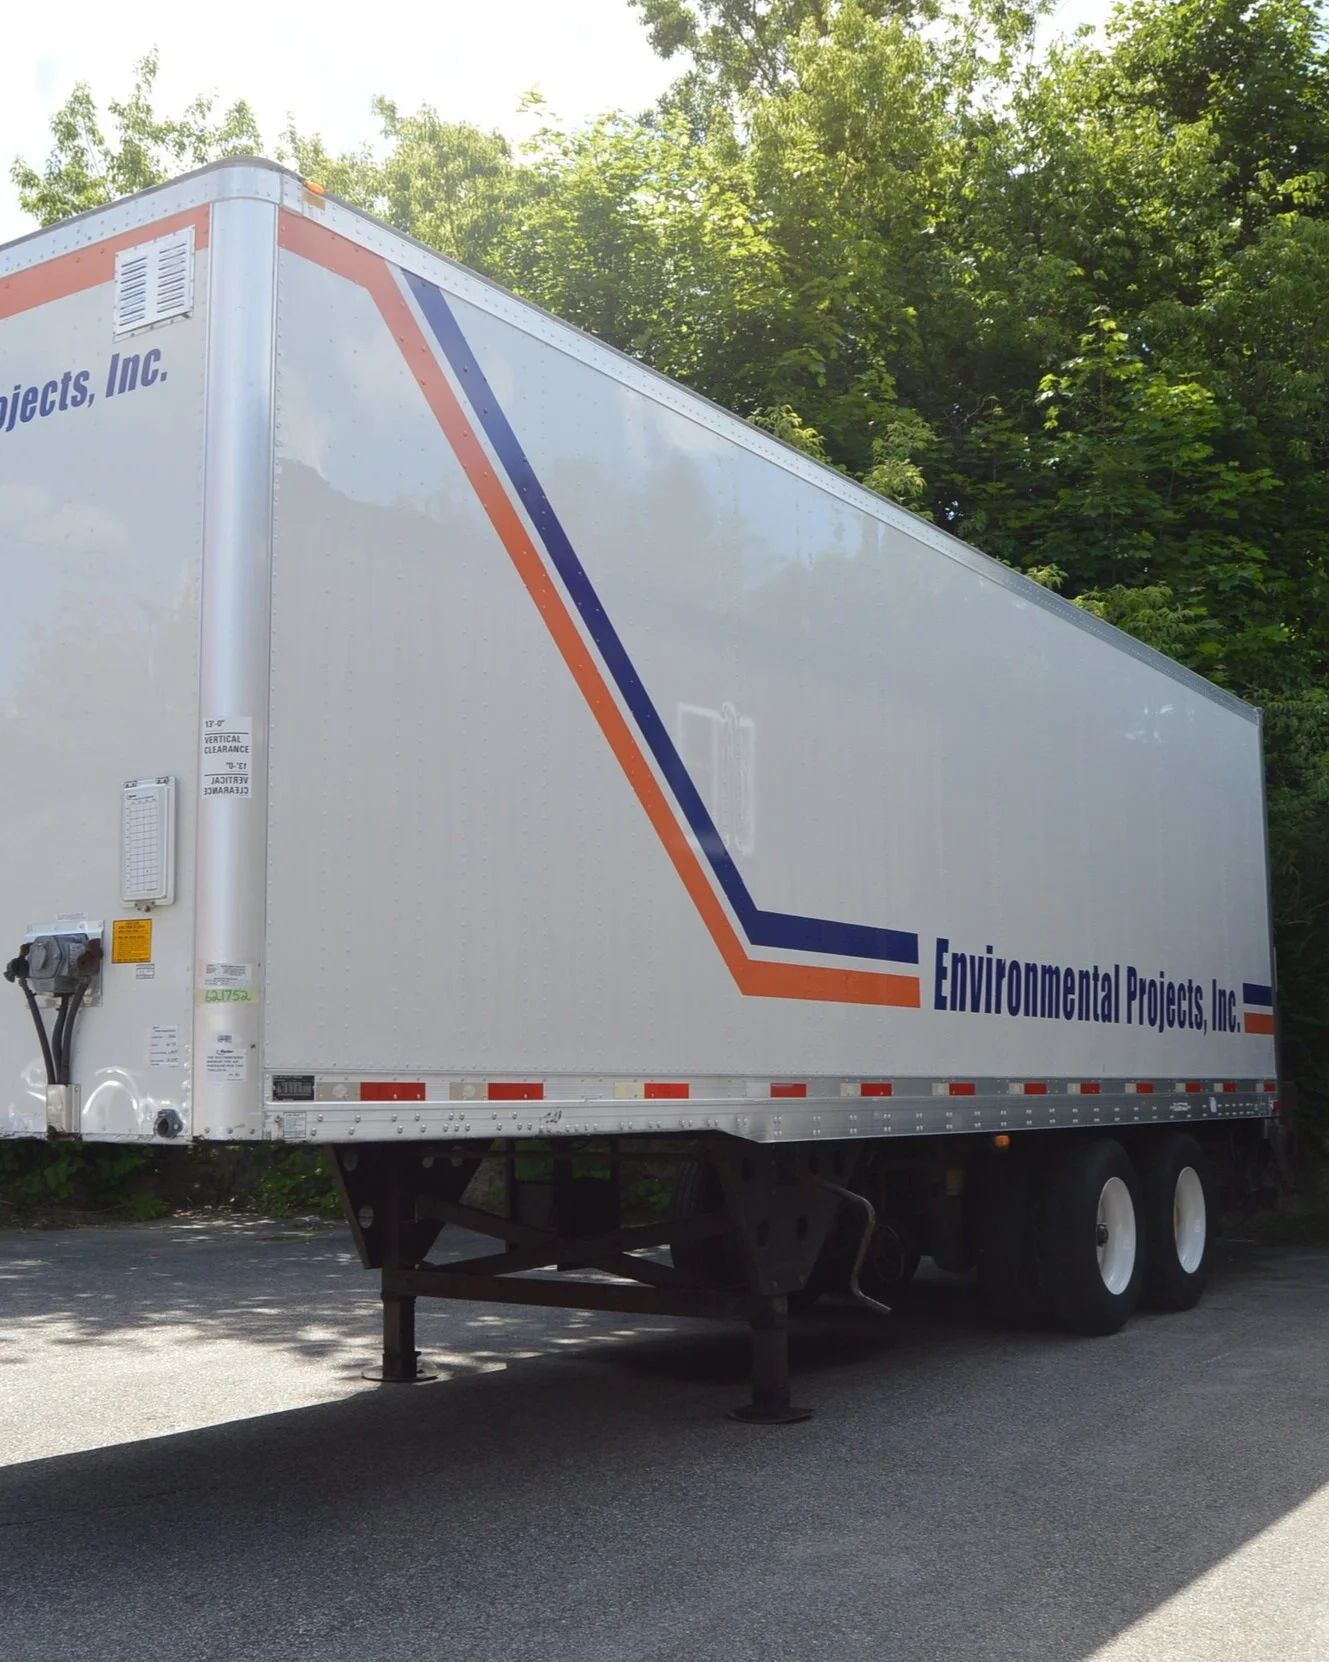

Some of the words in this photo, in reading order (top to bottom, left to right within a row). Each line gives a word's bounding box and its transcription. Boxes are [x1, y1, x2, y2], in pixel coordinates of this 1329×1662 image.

[105, 348, 168, 398] Inc.
[204, 735, 241, 744] VERTICAL
[204, 745, 249, 754] CLEARANCE
[933, 937, 1120, 1024] Environmental
[1126, 965, 1208, 1037] Projects,
[1211, 978, 1241, 1032] Inc.
